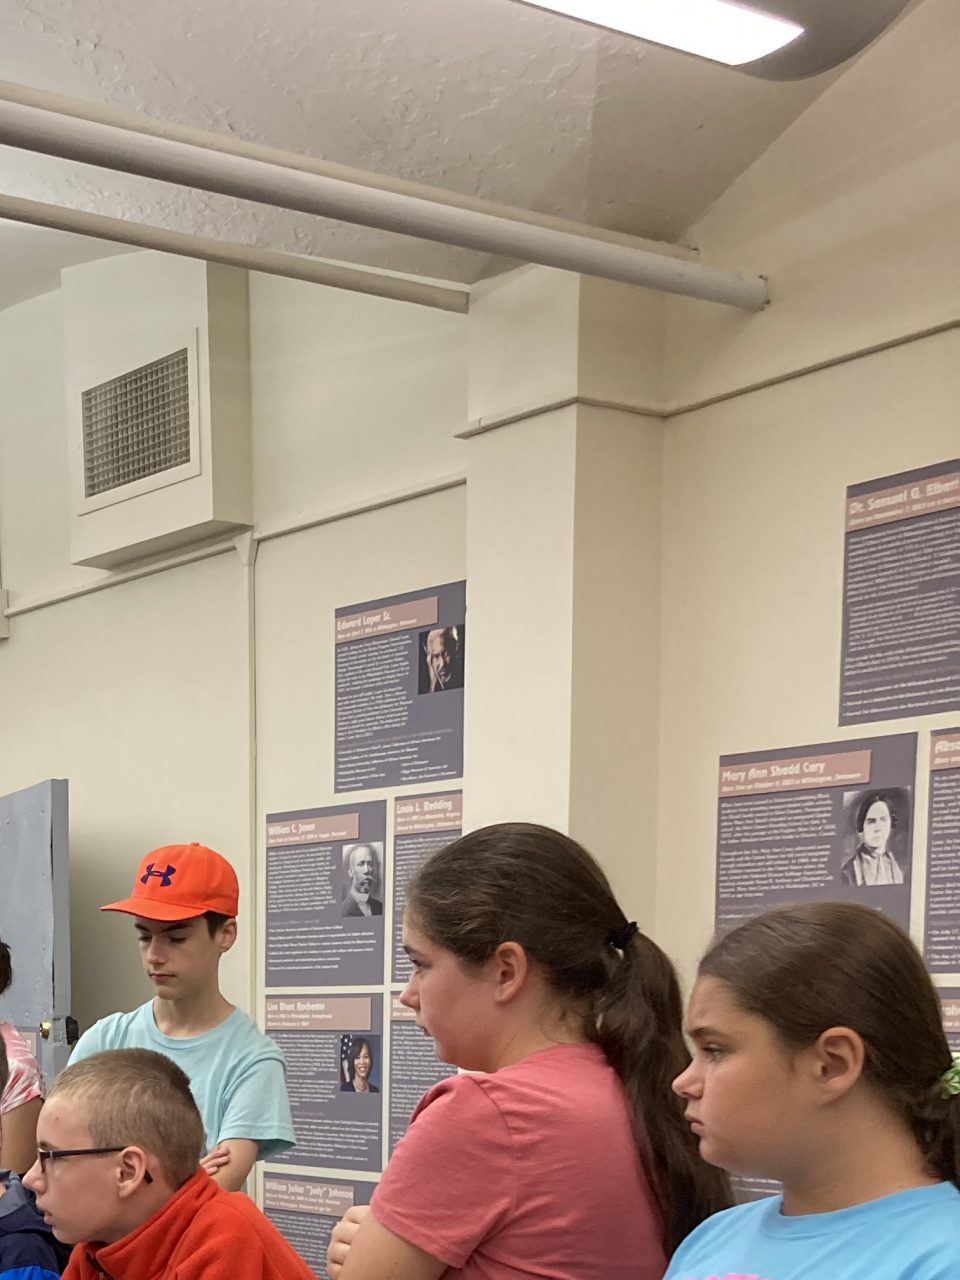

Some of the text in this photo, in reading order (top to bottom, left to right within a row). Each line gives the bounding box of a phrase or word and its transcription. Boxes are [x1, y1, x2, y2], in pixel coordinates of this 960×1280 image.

[722, 761, 826, 783] Mary Ann Shadd Cary
